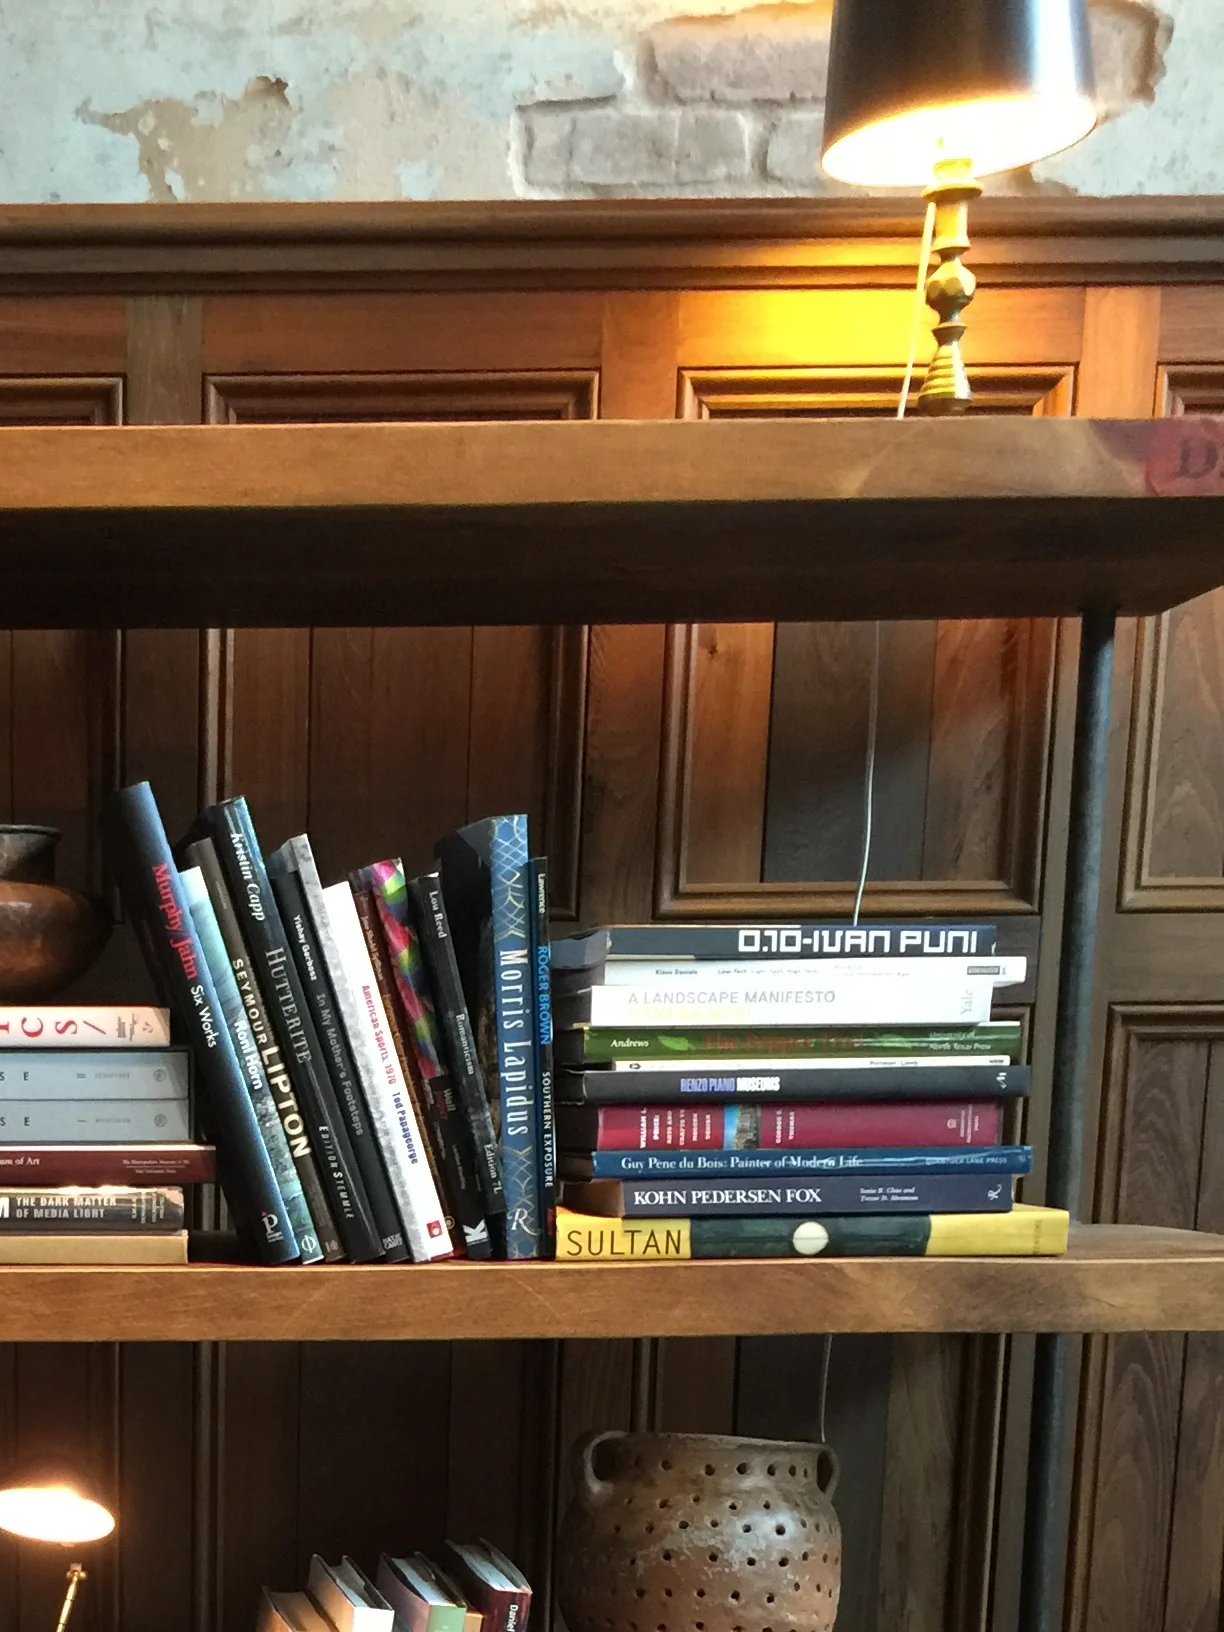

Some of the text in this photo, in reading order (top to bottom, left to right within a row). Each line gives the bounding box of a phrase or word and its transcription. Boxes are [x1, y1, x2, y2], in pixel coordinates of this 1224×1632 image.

[899, 929, 978, 954] PUNI
[361, 984, 381, 1031] American
[644, 990, 836, 1004] LANDSCAPE MANIFESTO
[190, 984, 220, 1049] Six Works
[246, 882, 339, 1169] Capp HUTTERITE EDITION
[429, 890, 498, 1180] Lou Reed Edition
[499, 948, 534, 1136] Morris Lapidus
[232, 958, 313, 1159] SEYMOUR LIPTON
[316, 993, 364, 1136] In My Footsteps
[537, 945, 554, 1188] ROGER BROWN SOUTHERN EXPOSURE
[709, 1077, 735, 1092] PIANO
[26, 1156, 41, 1166] Art
[621, 1154, 837, 1171] Guy du Painter of Modern
[16, 1196, 117, 1207] THE DARK MATTER
[633, 1187, 823, 1206] KOHN PEDERSEN FOX
[16, 1208, 105, 1219] OF MEDIA LIGHT
[565, 1229, 683, 1257] SULTAN
[506, 1604, 519, 1632] Daniel
